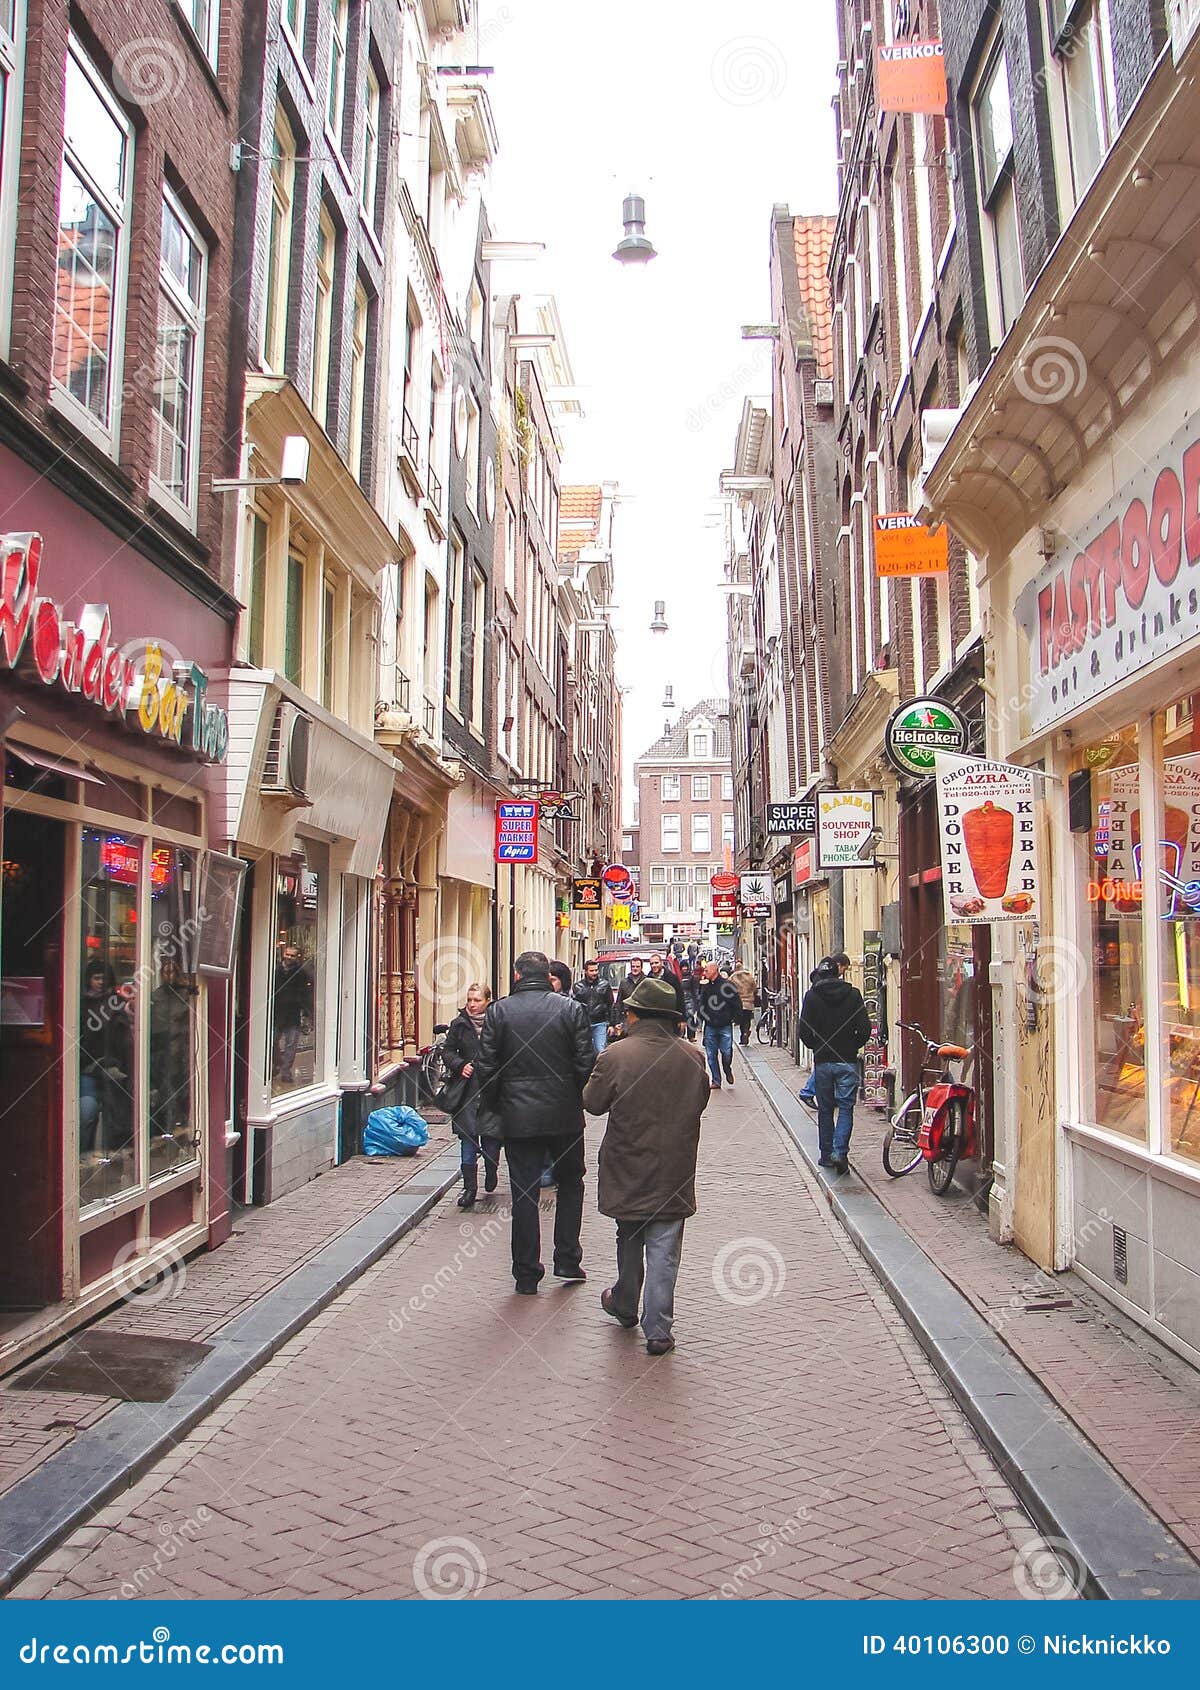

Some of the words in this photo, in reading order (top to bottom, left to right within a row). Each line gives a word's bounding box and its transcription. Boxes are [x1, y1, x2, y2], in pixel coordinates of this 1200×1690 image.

[1114, 588, 1197, 663] drinks
[895, 730, 959, 745] Heineken
[942, 763, 1031, 785] GROOTHANDEL
[964, 773, 1009, 785] AZRA
[822, 794, 872, 814] RAMBO
[772, 806, 816, 819] SUPER
[502, 820, 532, 831] SUPER
[822, 821, 871, 830] SOUVENIR
[499, 832, 534, 843] MARKET
[833, 831, 860, 839] SHOP
[504, 845, 529, 857] Agria
[944, 804, 964, 894] DÖNER
[1016, 801, 1035, 891] KEBAB
[823, 853, 859, 862] PHONE-C
[742, 891, 770, 902] Seeds
